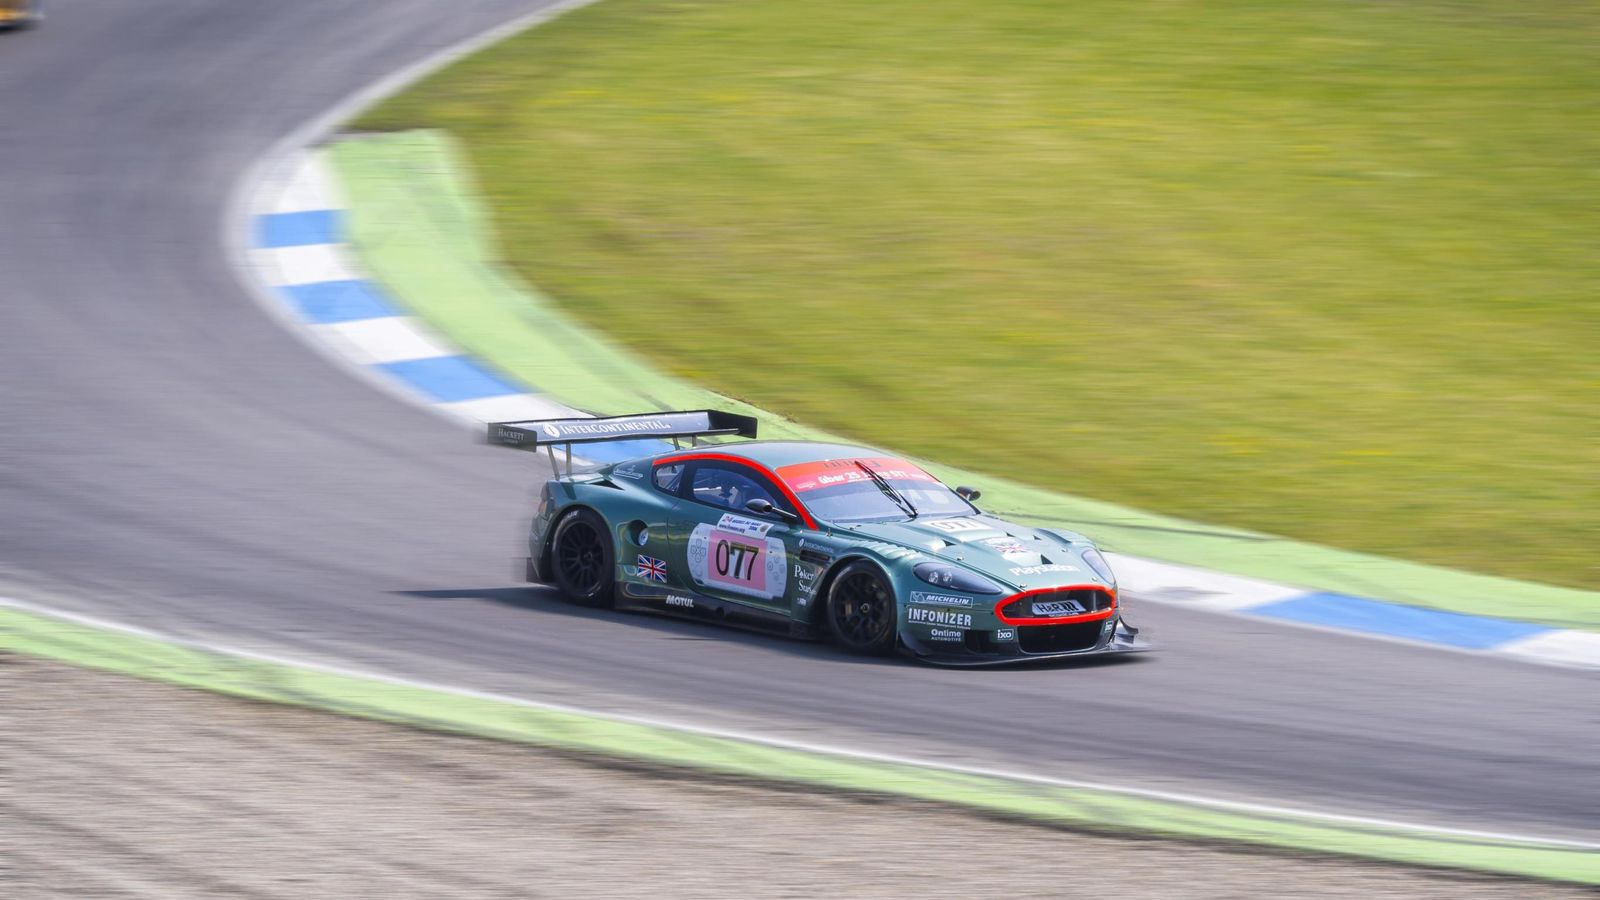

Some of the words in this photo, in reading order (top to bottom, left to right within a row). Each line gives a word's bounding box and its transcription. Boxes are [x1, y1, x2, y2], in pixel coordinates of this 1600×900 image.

[716, 539, 760, 581] 077
[666, 594, 694, 608] MOTUL
[926, 595, 969, 605] MICHELIN
[908, 608, 972, 626] INFONIZER
[931, 628, 962, 637] Ontime
[997, 629, 1012, 638] ixo
